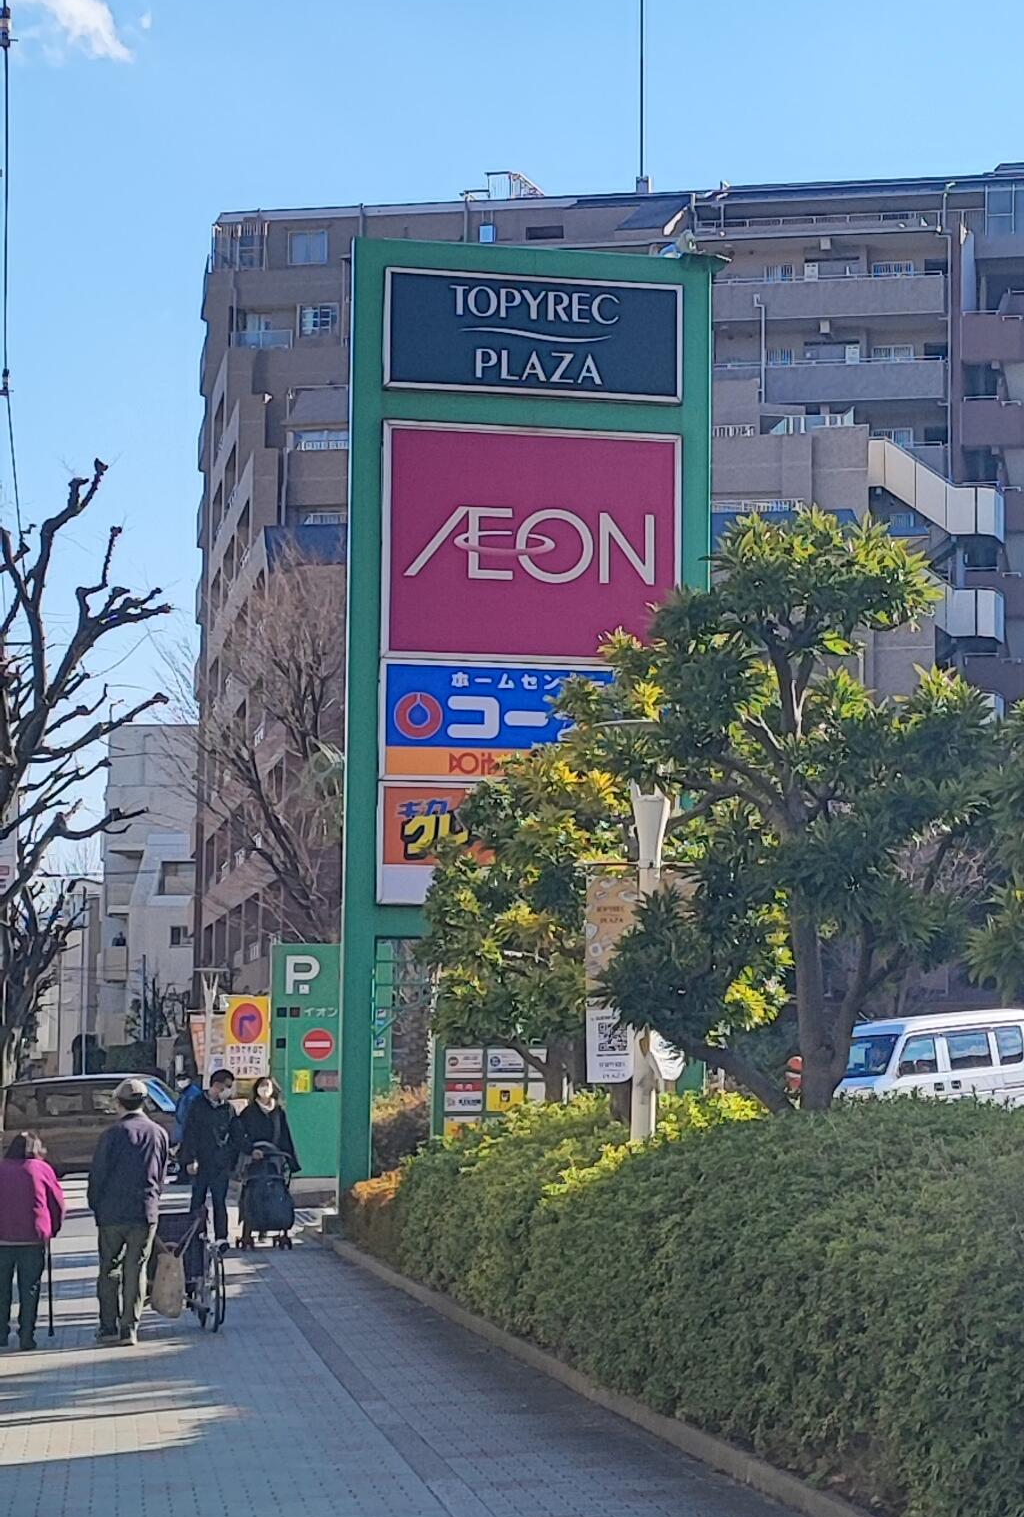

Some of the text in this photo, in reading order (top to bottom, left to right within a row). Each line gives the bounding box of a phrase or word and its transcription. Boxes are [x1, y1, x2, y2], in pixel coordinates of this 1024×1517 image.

[450, 284, 620, 325] TOPYREC
[474, 348, 603, 385] PLAZA
[451, 671, 605, 691] ホームセンー
[303, 1007, 338, 1018] イオン
